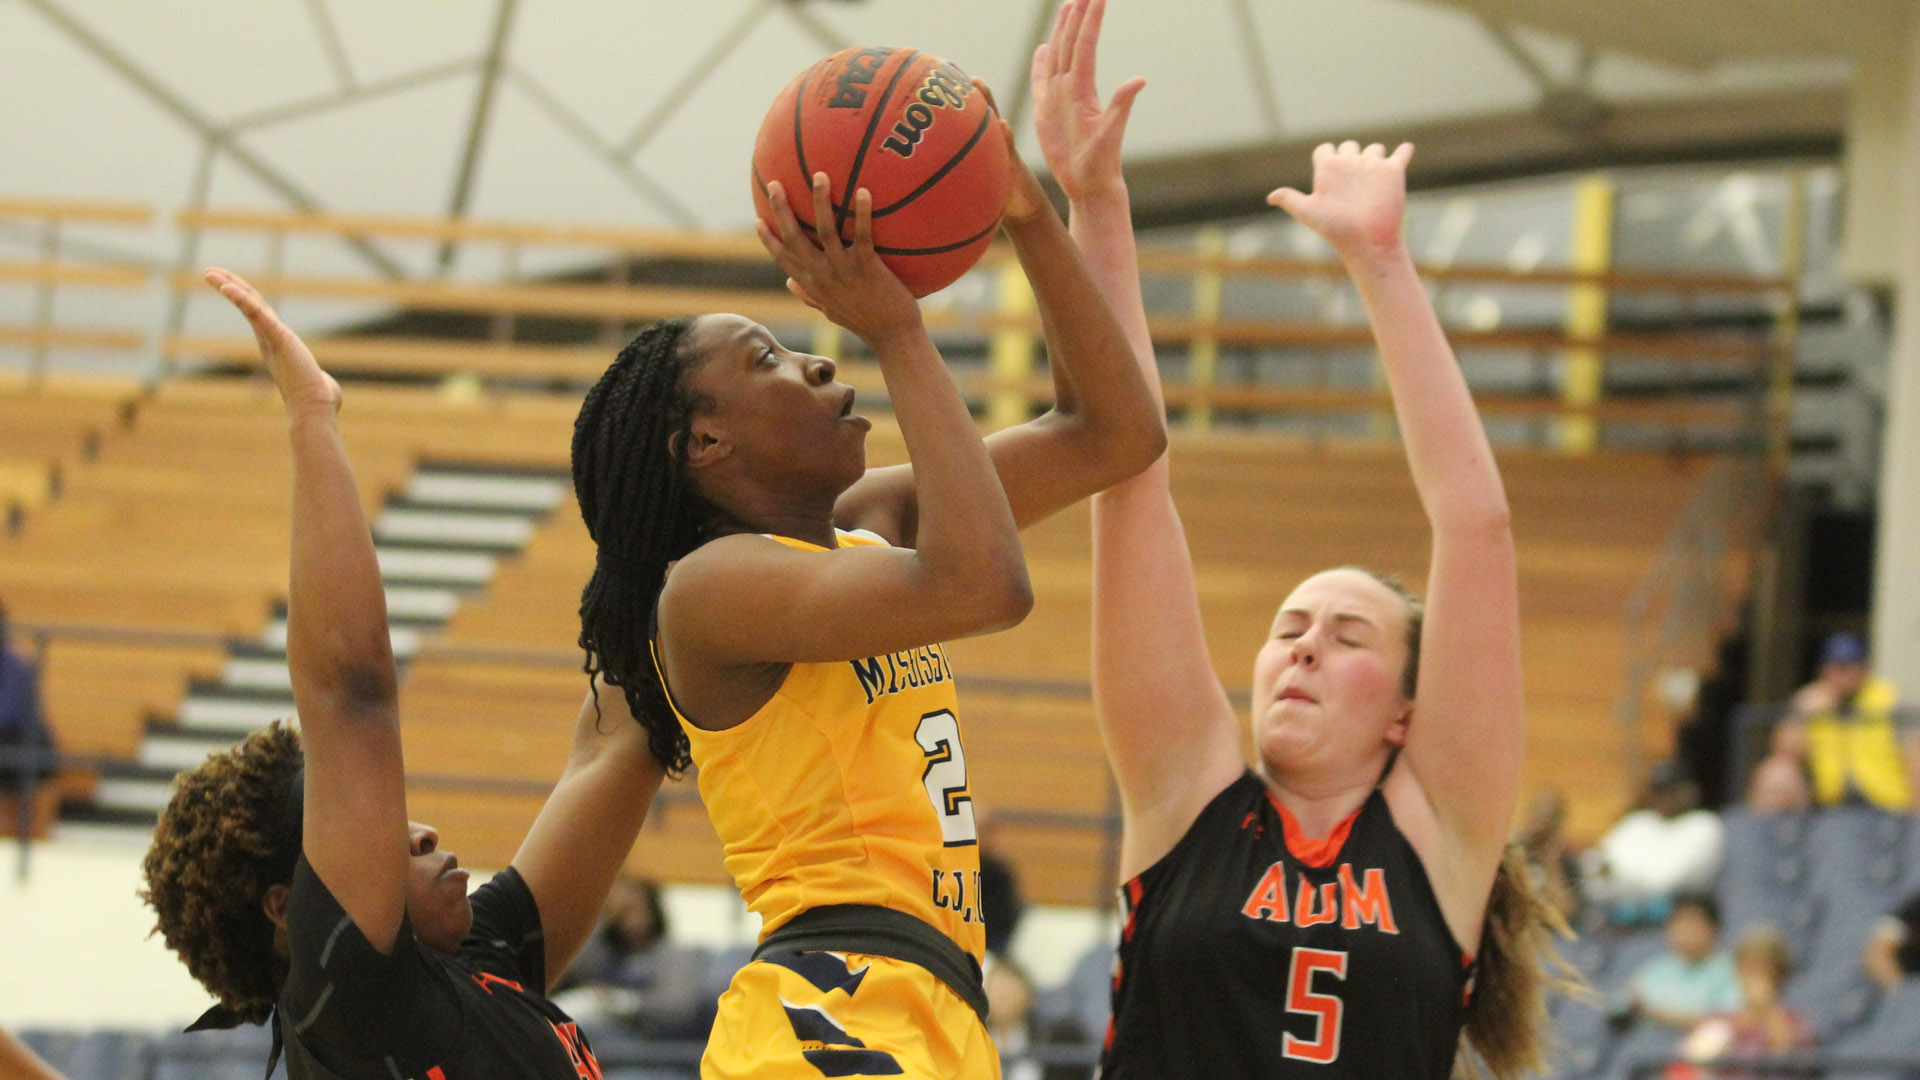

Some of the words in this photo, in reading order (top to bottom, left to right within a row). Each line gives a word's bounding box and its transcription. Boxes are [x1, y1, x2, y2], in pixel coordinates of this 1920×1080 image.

[829, 47, 892, 108] CAA
[1241, 861, 1400, 934] AUM
[1282, 946, 1349, 1064] 5
